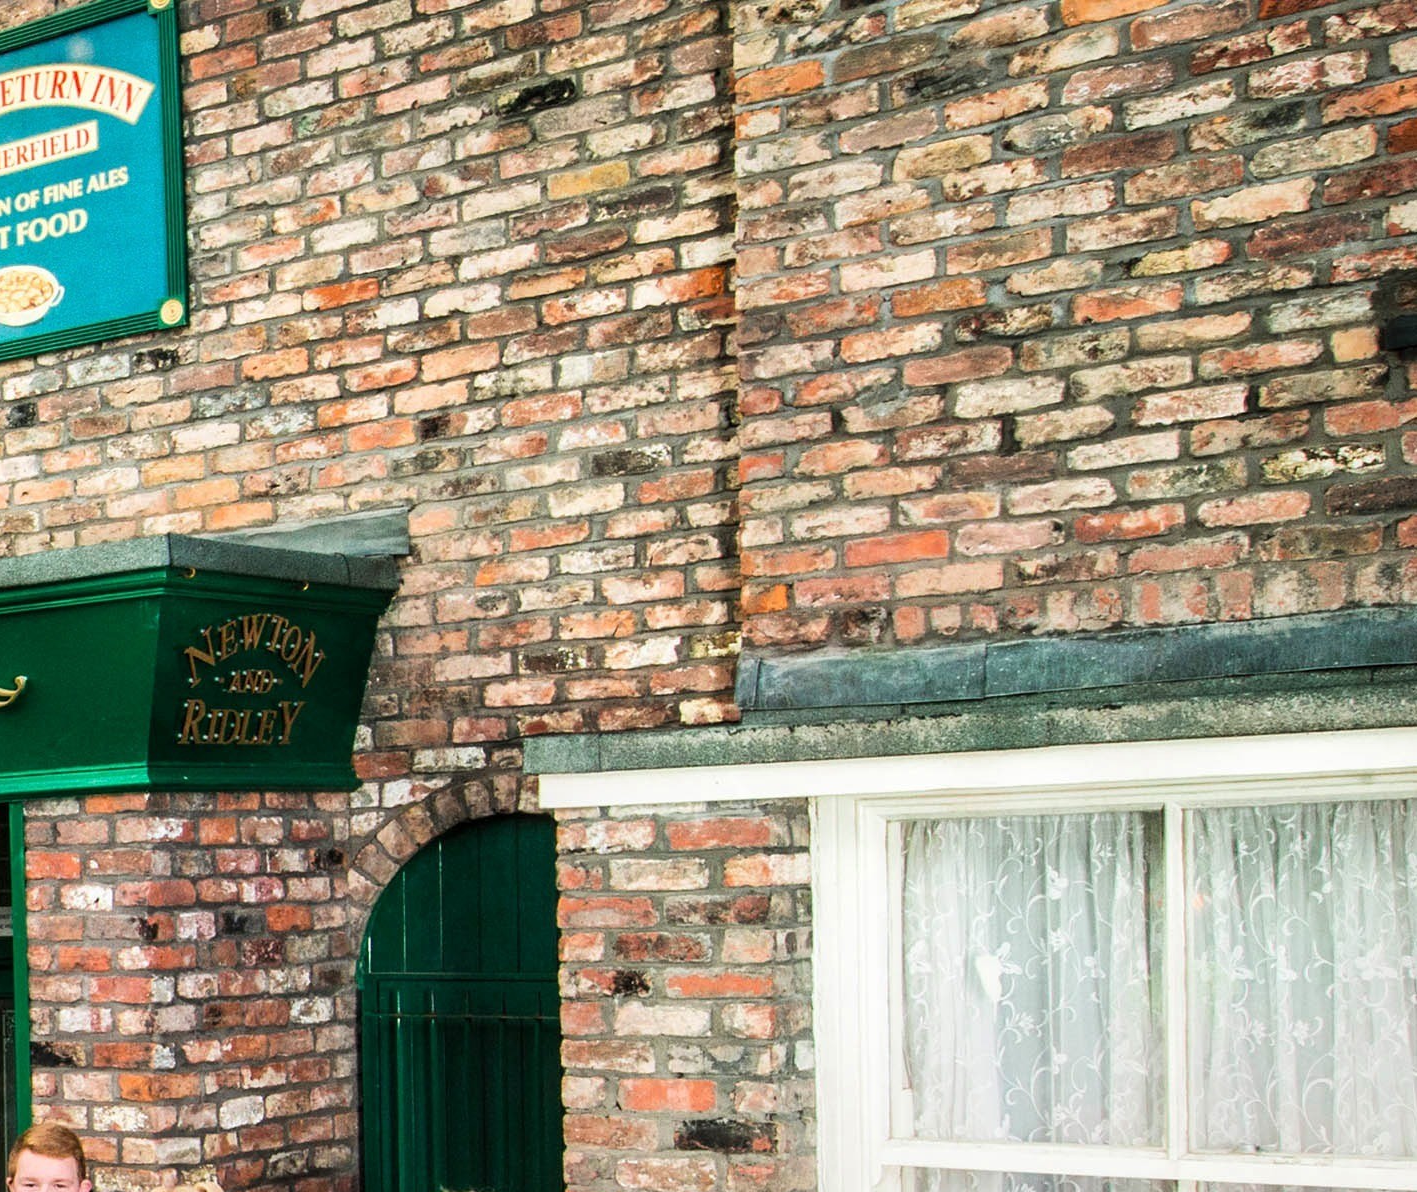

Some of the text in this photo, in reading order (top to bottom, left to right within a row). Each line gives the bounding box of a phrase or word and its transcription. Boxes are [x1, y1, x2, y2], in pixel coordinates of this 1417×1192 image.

[91, 73, 144, 115] INN
[15, 191, 41, 213] OF
[43, 179, 83, 207] FINE
[86, 166, 129, 194] ALES
[17, 209, 88, 247] FOOD
[184, 613, 326, 688] NEWTON
[228, 669, 274, 693] AND
[177, 699, 306, 745] RIDLEY
